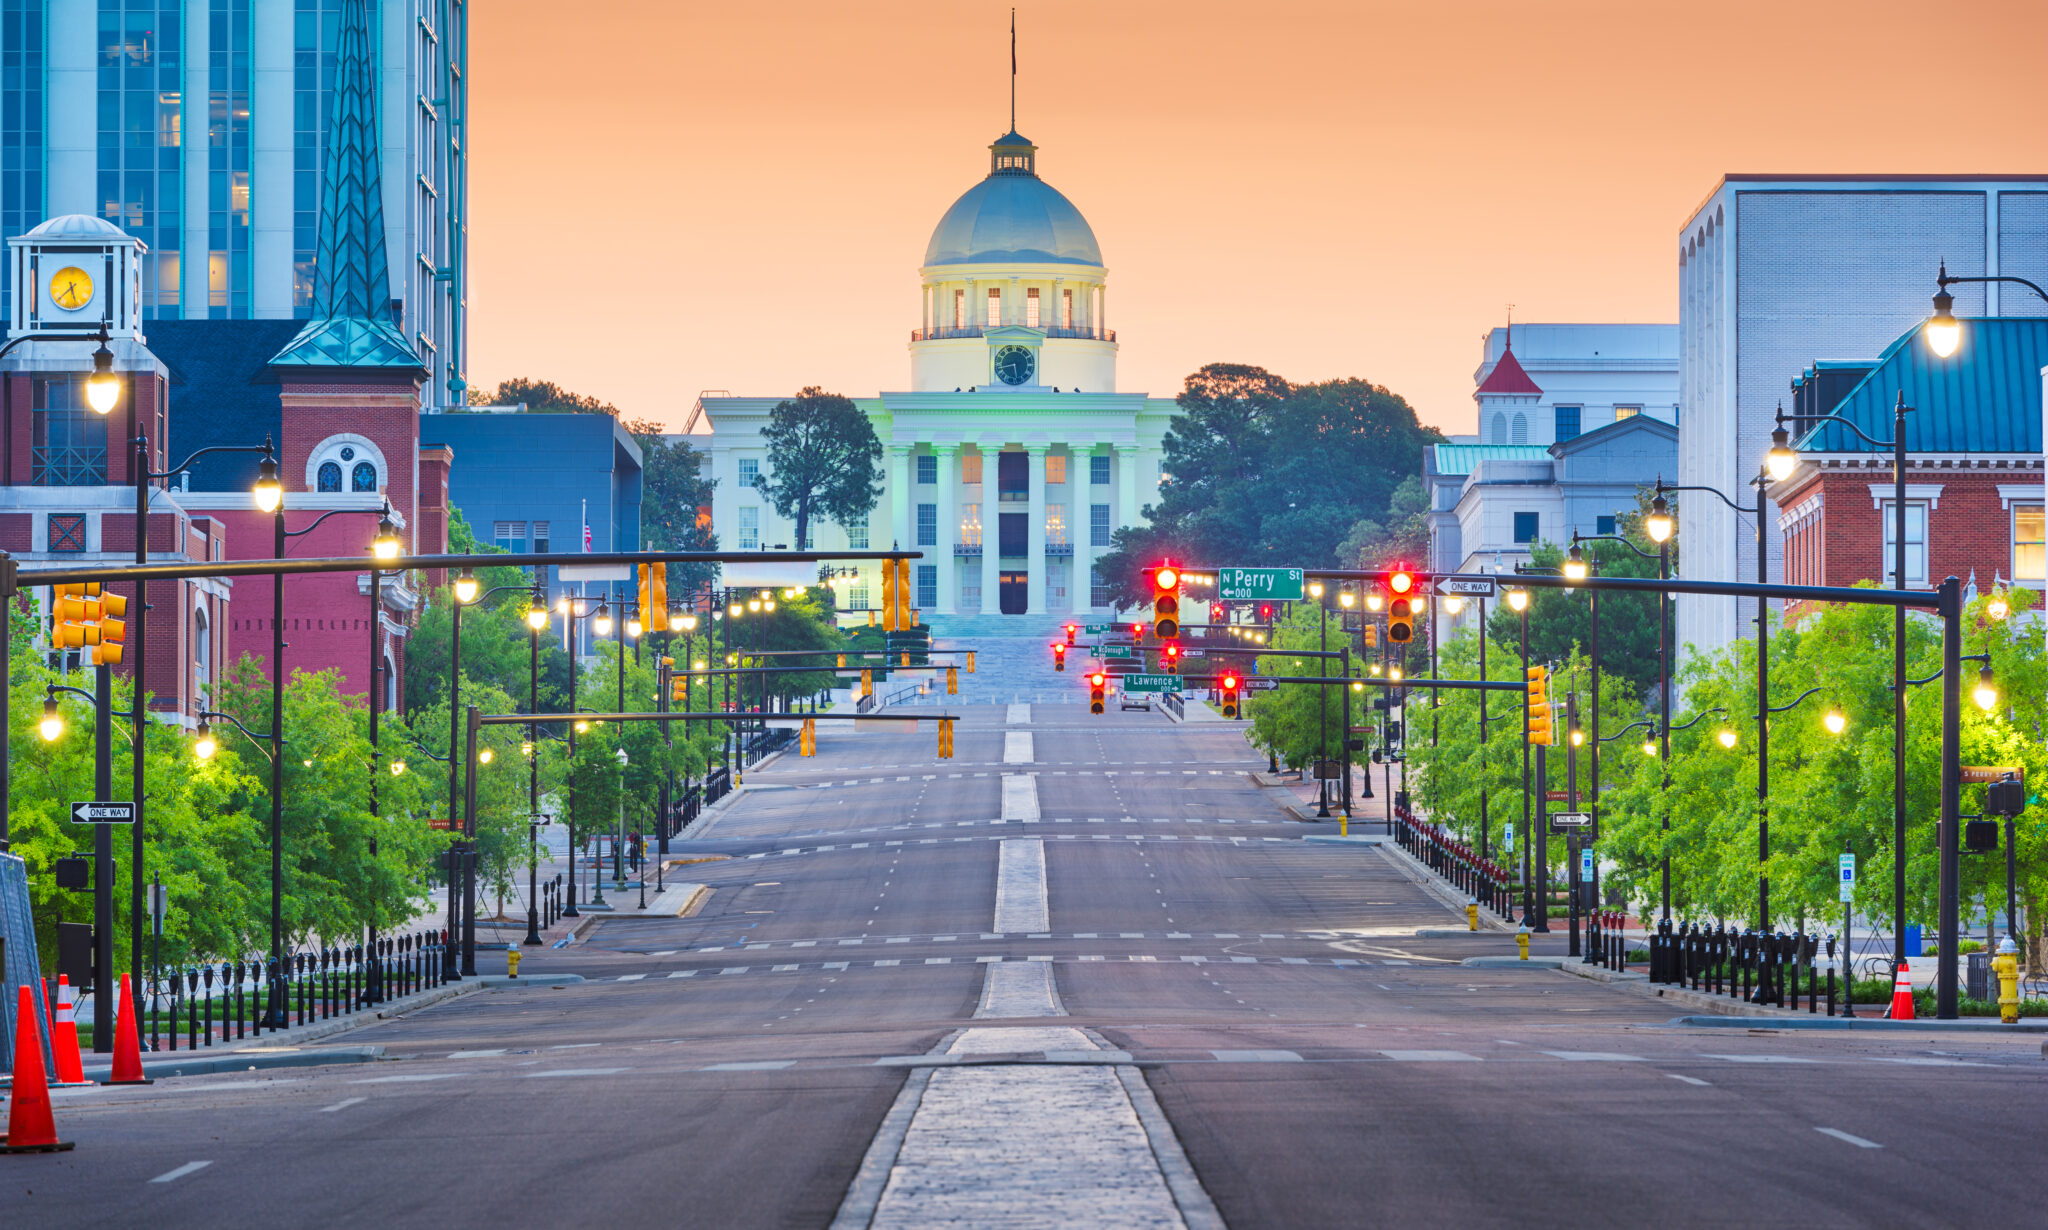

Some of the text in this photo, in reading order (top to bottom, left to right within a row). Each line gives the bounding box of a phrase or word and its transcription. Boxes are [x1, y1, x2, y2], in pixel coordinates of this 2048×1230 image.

[1223, 570, 1300, 591] N Perry St
[1451, 582, 1488, 592] ONE WAY
[1235, 588, 1251, 598] 000
[1133, 675, 1173, 686] Lawrence
[90, 808, 127, 816] ONE WAY
